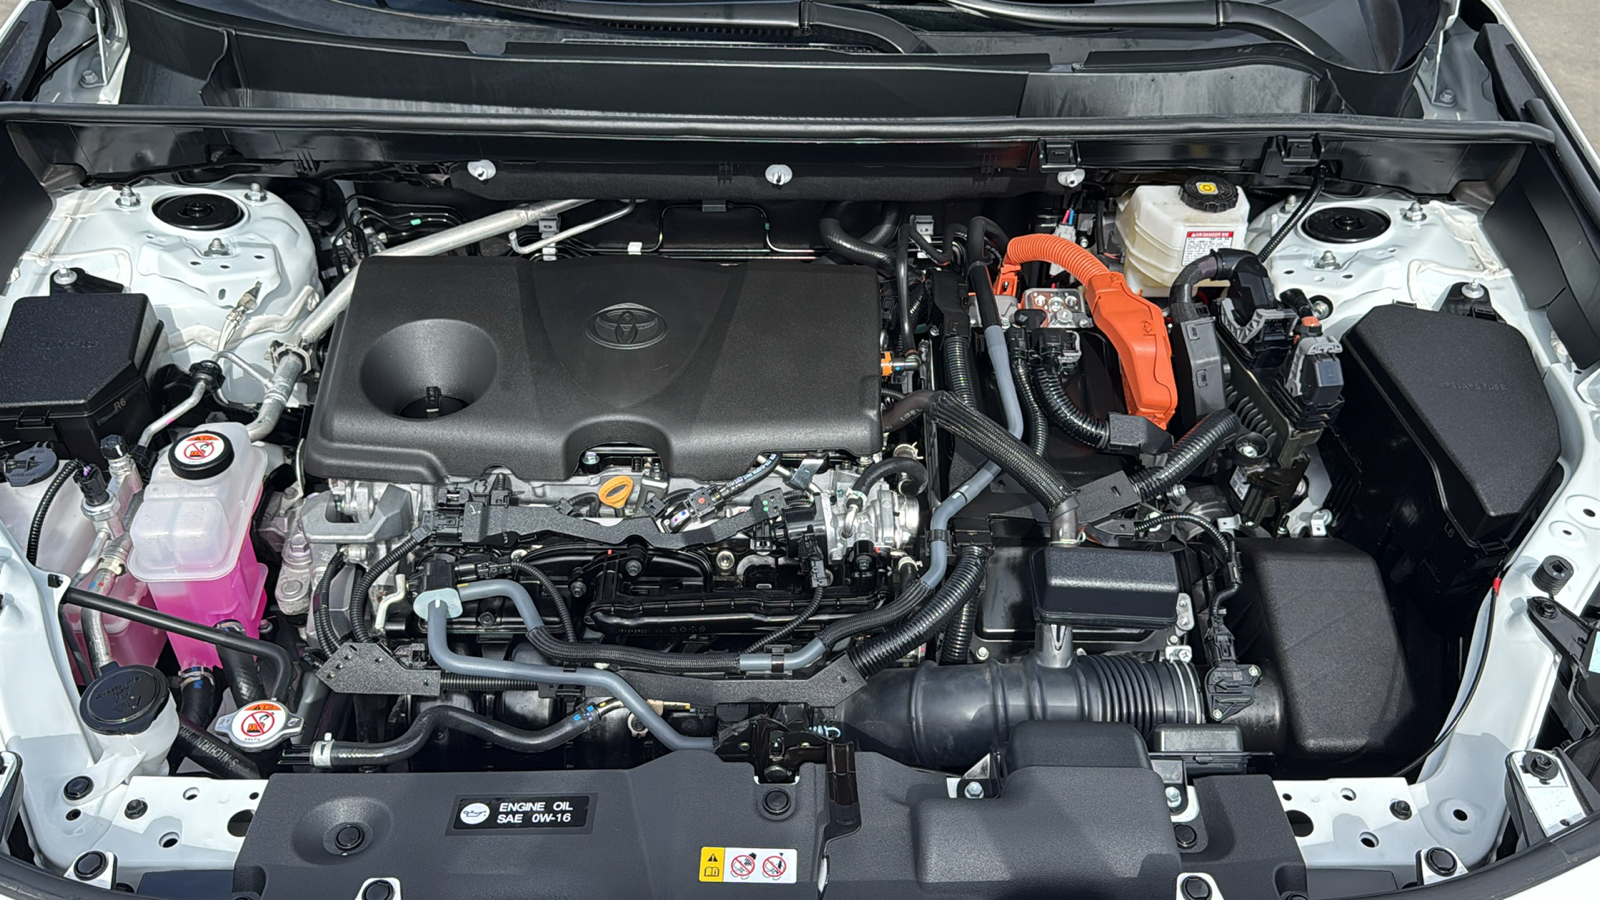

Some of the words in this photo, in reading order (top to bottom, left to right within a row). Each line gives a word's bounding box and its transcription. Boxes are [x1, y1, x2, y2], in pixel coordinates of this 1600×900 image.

[499, 802, 546, 812] ENGINE
[553, 801, 574, 811] OIL
[497, 813, 523, 824] SAE
[531, 813, 572, 823] 0W-16
